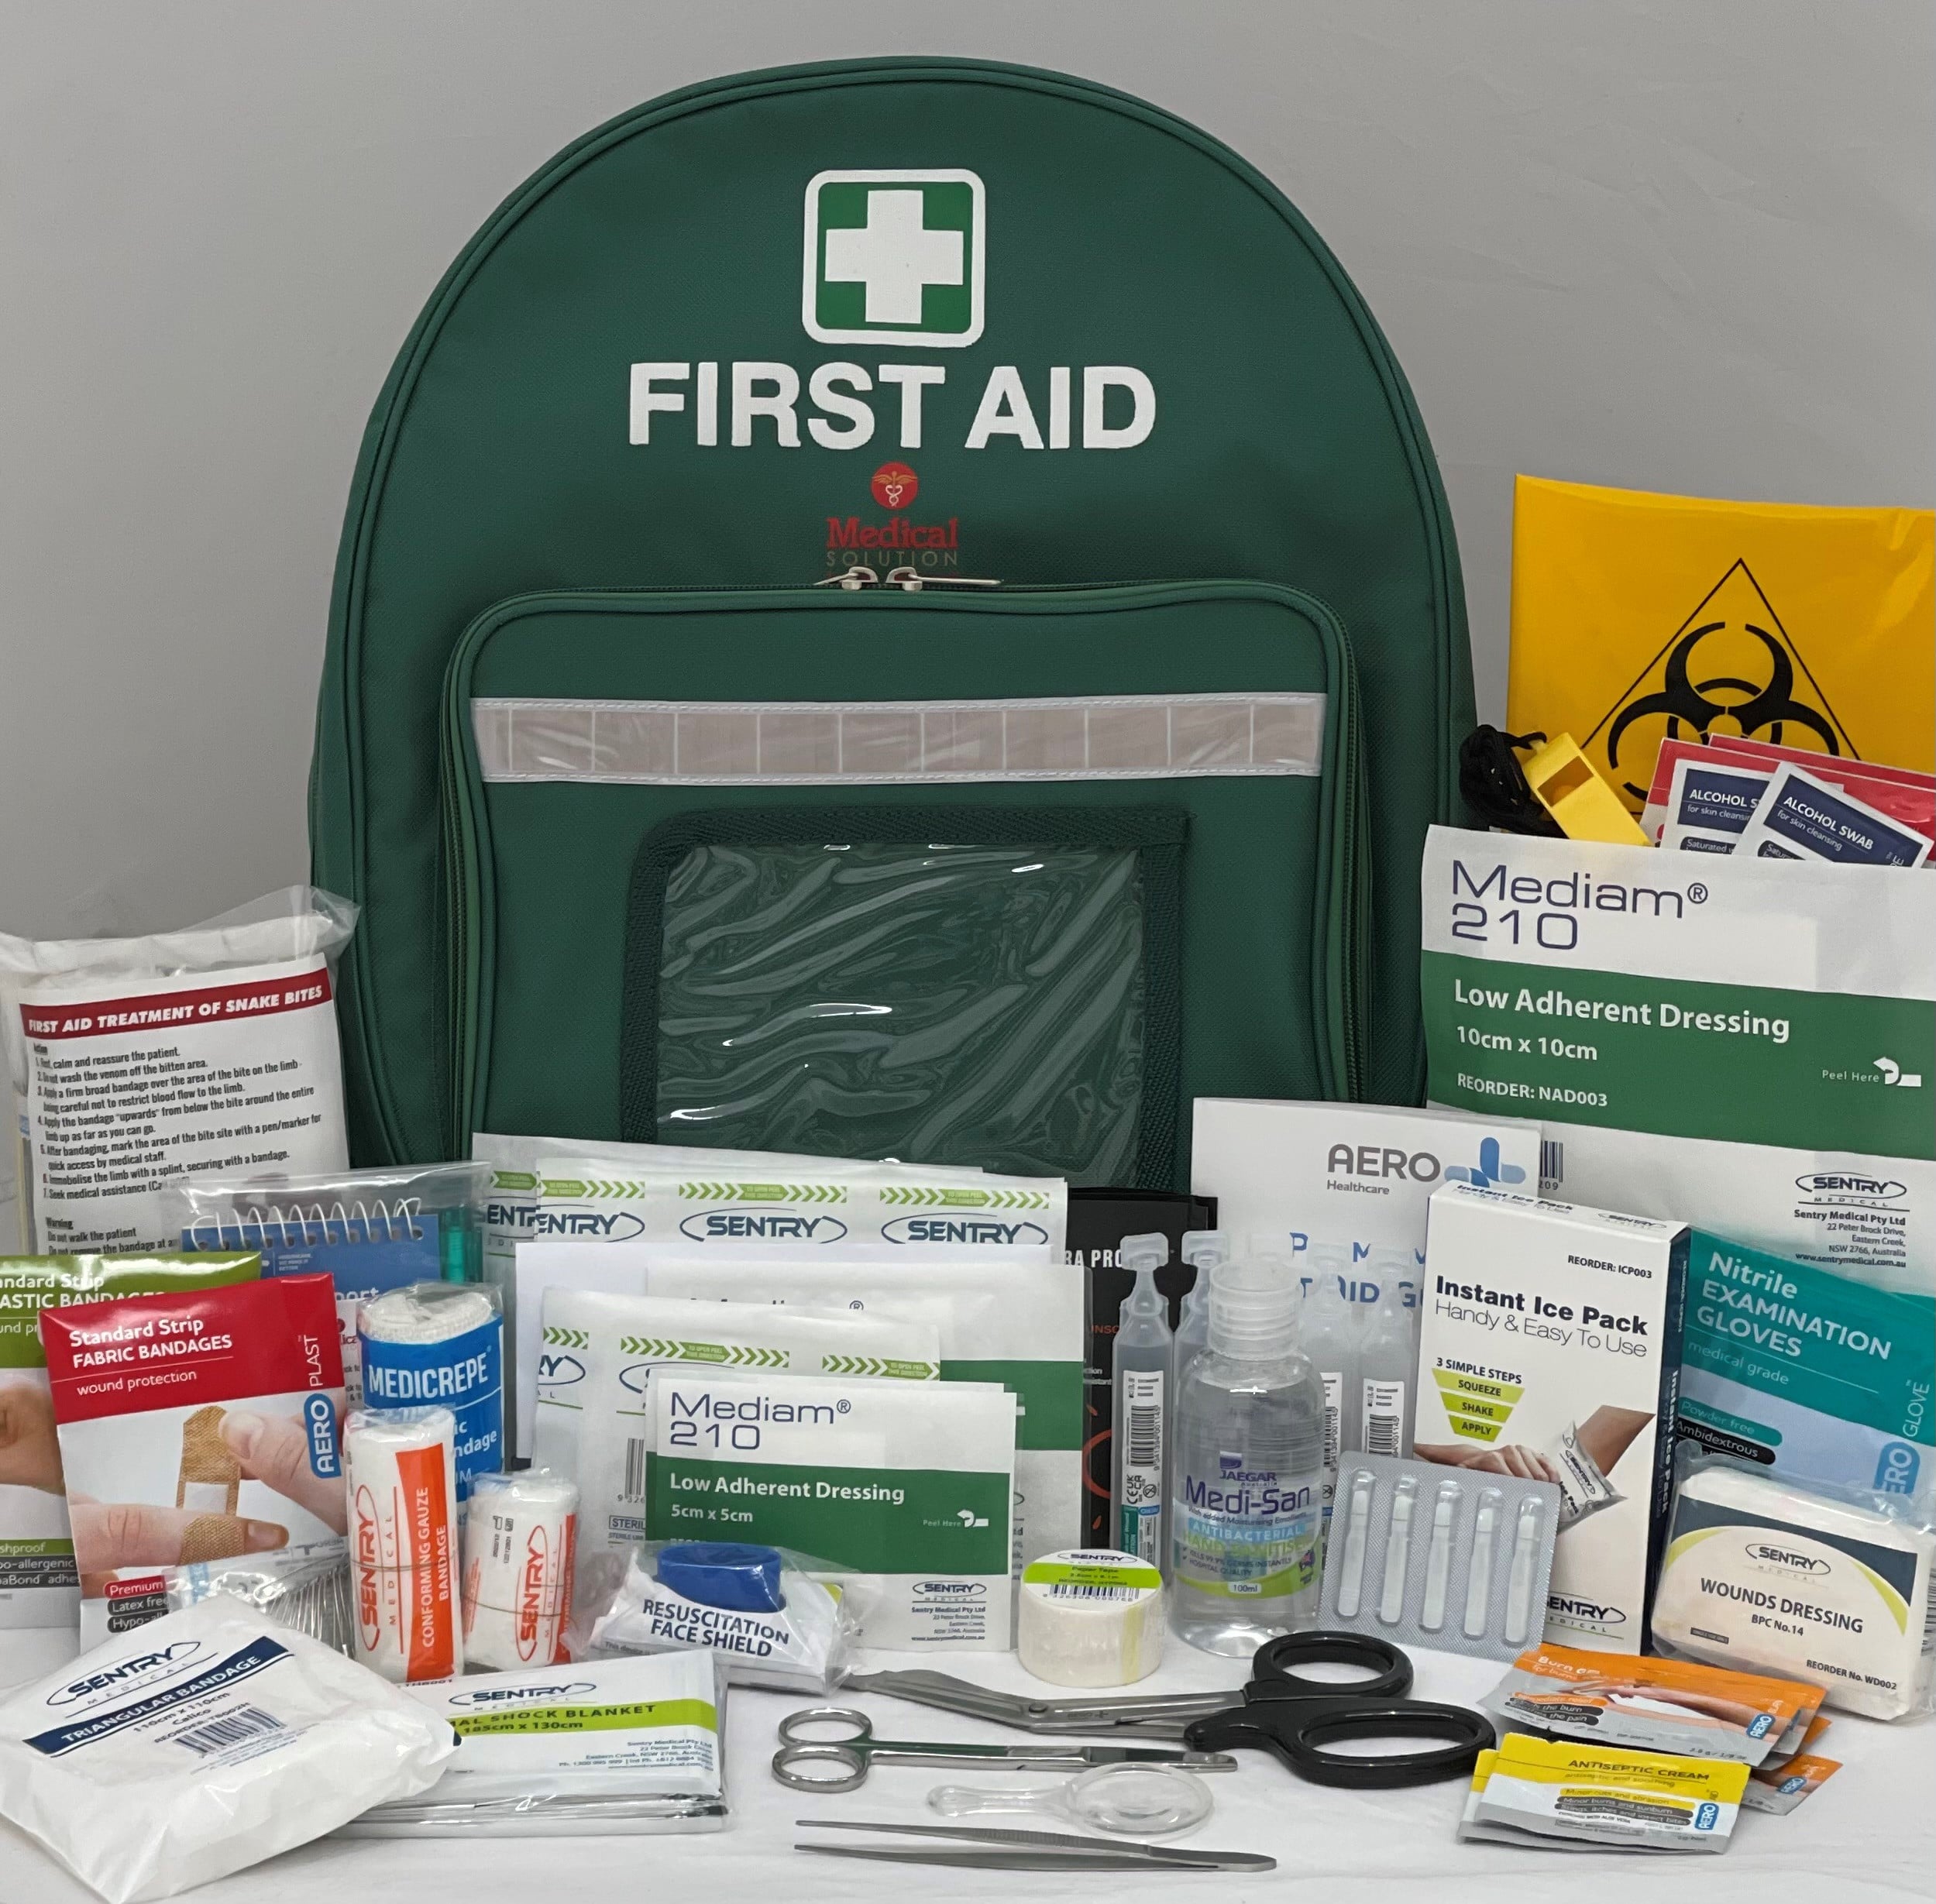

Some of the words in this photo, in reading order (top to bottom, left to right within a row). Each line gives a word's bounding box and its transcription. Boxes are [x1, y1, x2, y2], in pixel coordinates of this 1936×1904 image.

[629, 361, 945, 449] FIRST
[965, 366, 1157, 449] AID
[826, 517, 958, 549] Medical
[826, 551, 958, 567] SOLUTION
[1687, 804, 1698, 813] for
[1700, 806, 1718, 816] skin
[1690, 789, 1747, 807] ALCOHOL
[1777, 809, 1790, 821] for
[1790, 816, 1806, 830] skin
[1805, 824, 1842, 851] cleansing
[1783, 796, 1837, 831] ALCOHOL
[1838, 825, 1873, 851] SWAB
[1687, 839, 1728, 852] Saturated
[1452, 902, 1578, 950] 210
[29, 1019, 58, 1033] FIRST
[62, 1018, 92, 1032] AID
[97, 1005, 194, 1028] TREATMENT
[198, 1002, 221, 1016] OF
[225, 994, 280, 1012] SNAKE
[284, 985, 322, 1005] BITES
[1454, 979, 1509, 1006] Low
[1515, 988, 1651, 1026] Adherent
[1659, 1005, 1790, 1043] Dressing
[1457, 1026, 1512, 1051] 10cm
[1518, 1040, 1531, 1053] x
[1538, 1036, 1597, 1060] 10cm
[53, 1058, 72, 1069] calm
[75, 1057, 90, 1067] and
[93, 1053, 129, 1065] reassure
[60, 1072, 81, 1084] wash
[100, 1068, 128, 1080] venom
[159, 1060, 185, 1074] bitten
[1822, 1068, 1846, 1081] Peel
[1850, 1071, 1879, 1083] Here
[85, 1084, 110, 1096] broad
[112, 1081, 149, 1092] bandage
[151, 1091, 175, 1103] blood
[1458, 1074, 1535, 1100] REORDER:
[1539, 1086, 1608, 1107] NAD003
[78, 1114, 115, 1126] bandage
[184, 1102, 208, 1113] below
[245, 1092, 274, 1105] around
[291, 1086, 315, 1098] entire
[262, 1116, 309, 1134] pen/marker
[109, 1153, 142, 1166] medical
[187, 1159, 223, 1172] securing
[1327, 1143, 1441, 1183] AERO
[67, 1187, 99, 1199] medical
[101, 1183, 146, 1196] assistance
[1327, 1180, 1390, 1195] Healthcare
[1813, 1177, 1888, 1194] SENTRY
[1814, 1197, 1888, 1208] MEDICAL
[1794, 1209, 1827, 1221] Sentry
[1830, 1211, 1868, 1222] Medical
[1871, 1215, 1887, 1225] Pty
[1890, 1216, 1906, 1225] Ltd
[707, 1215, 822, 1238] SENTRY
[908, 1220, 1023, 1244] SENTRY
[1839, 1223, 1859, 1232] Peter
[1861, 1225, 1882, 1235] Brock
[1883, 1228, 1906, 1237] Drive,
[1852, 1235, 1880, 1245] Eastern
[1882, 1237, 1906, 1247] Creek,
[1796, 1252, 1906, 1268] www.sentrymedical.com.au
[1872, 1248, 1906, 1257] Australia
[1568, 1255, 1616, 1273] REORDER:
[1618, 1264, 1652, 1279] ICP003
[1708, 1251, 1798, 1299] Nitrile
[1436, 1275, 1525, 1311] Instant
[1535, 1296, 1573, 1321] Ice
[1583, 1306, 1649, 1335] Pack
[68, 1319, 154, 1348] Standard
[158, 1315, 205, 1335] Strip
[1436, 1299, 1500, 1331] Handy
[1504, 1315, 1519, 1332] &
[1524, 1318, 1573, 1346] Easy
[1577, 1328, 1601, 1349] To
[1606, 1335, 1647, 1357] Use
[1697, 1306, 1802, 1357] GLOVES
[1703, 1279, 1891, 1360] EXAMINATION
[72, 1348, 134, 1368] FABRIC
[139, 1335, 232, 1360] BANDAGES
[304, 1335, 323, 1387] PLAST
[1688, 1341, 1743, 1369] medical
[1747, 1359, 1789, 1385] grade
[1436, 1357, 1443, 1367] 3
[1446, 1359, 1485, 1376] SIMPLE
[1487, 1369, 1522, 1384] STEPS
[77, 1380, 123, 1396] wound
[127, 1370, 197, 1394] protection
[1458, 1379, 1501, 1397] SQUEEZE
[1462, 1402, 1494, 1417] SHAKE
[1681, 1401, 1728, 1425] Powder
[1730, 1417, 1755, 1435] free
[1903, 1382, 1931, 1437] GLOVE
[314, 1400, 335, 1473] AERO
[670, 1422, 760, 1450] 210
[1461, 1421, 1491, 1435] APPLY
[1676, 1422, 1759, 1458] Ambidextrous
[1219, 1470, 1277, 1482] JAEGAR
[670, 1473, 710, 1491] Low
[714, 1477, 810, 1498] Adherent
[816, 1481, 905, 1504] Dressing
[1185, 1475, 1310, 1515] Medi-San
[416, 1486, 430, 1539] GAUZE
[671, 1504, 703, 1519] 5cm
[707, 1510, 716, 1520] x
[720, 1508, 753, 1523] 5cm
[923, 1518, 939, 1527] Peel
[1192, 1521, 1302, 1541] ANTIBACTERIAL
[436, 1525, 449, 1602] BANDAGE
[1071, 1553, 1125, 1562] SENTRY
[1759, 1546, 1818, 1570] SENTRY
[359, 1518, 377, 1627] SENTRY
[109, 1580, 163, 1596] Premium
[416, 1541, 434, 1648] CONFORMING
[521, 1546, 545, 1642] SENTRY
[924, 1583, 975, 1593] SENTRY
[1233, 1584, 1258, 1593] 100ml
[112, 1598, 144, 1613] Latex
[1700, 1578, 1776, 1610] WOUNDS
[1780, 1599, 1863, 1634] DRESSING
[642, 1599, 789, 1645] RESUSCITATION
[1751, 1614, 1772, 1627] BPC
[1774, 1619, 1804, 1636] No.14
[651, 1619, 697, 1643] FACE
[701, 1630, 772, 1657] SHIELD
[67, 1646, 177, 1696] SENTRY
[1538, 1655, 1573, 1672] Burn
[1807, 1659, 1847, 1677] REORDER
[1849, 1670, 1863, 1682] No.
[1865, 1675, 1896, 1690] WD002
[60, 1692, 176, 1743] TRIANGULAR
[177, 1655, 262, 1698] BANDAGE
[473, 1683, 572, 1703] SENTRY
[171, 1709, 211, 1726] Calico
[490, 1710, 558, 1723] SHOCK
[566, 1705, 656, 1718] BLANKET
[532, 1721, 583, 1731] 130cm
[1750, 1715, 1773, 1737] AERO
[1568, 1759, 1654, 1774] ANTISEPTIC
[1658, 1769, 1710, 1780] CREAM
[1698, 1804, 1716, 1830] AERO
